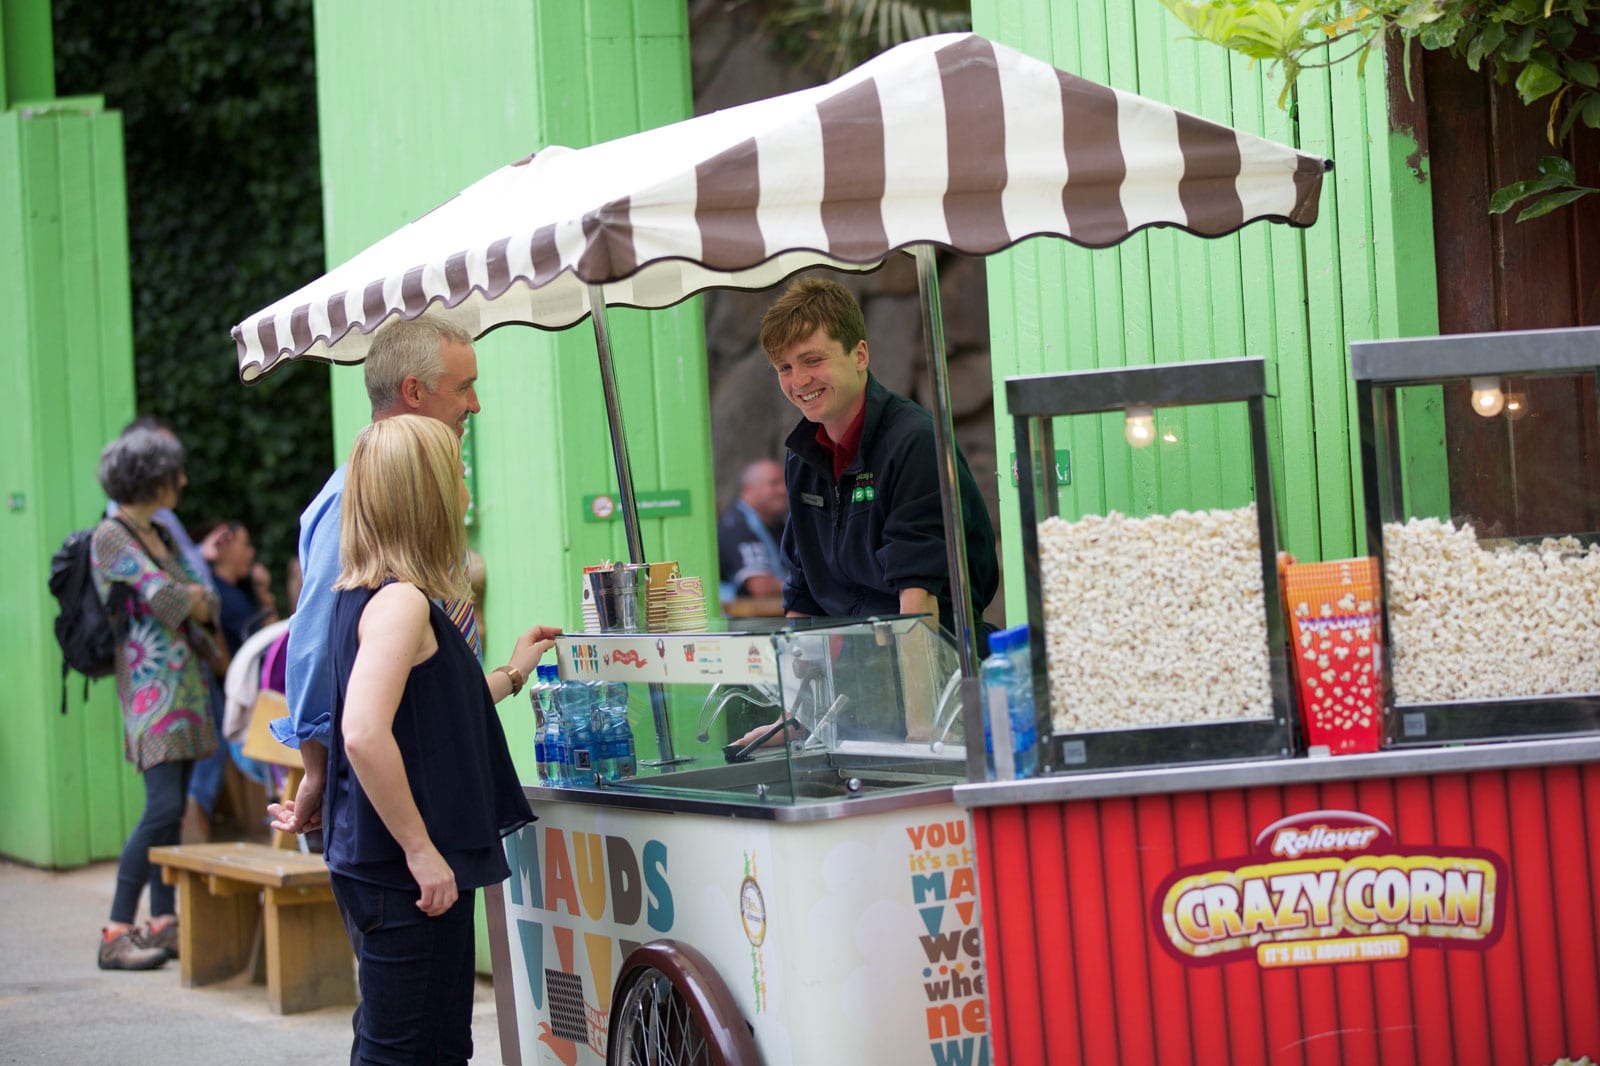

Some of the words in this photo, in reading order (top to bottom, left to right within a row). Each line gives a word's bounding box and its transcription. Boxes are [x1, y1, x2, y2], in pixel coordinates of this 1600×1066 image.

[1298, 614, 1371, 632] POPCORN
[572, 644, 598, 658] MAUDS
[905, 820, 966, 850] YOU
[1273, 827, 1377, 857] Rollover
[909, 850, 942, 872] it's
[504, 825, 675, 933] MAUDS
[1176, 870, 1339, 943] CRAZY
[1345, 868, 1484, 927] CORN
[1264, 946, 1289, 963] IT'S
[1292, 944, 1314, 961] ALL
[1316, 942, 1358, 960] ABOUT
[1360, 938, 1401, 957] TASTE!
